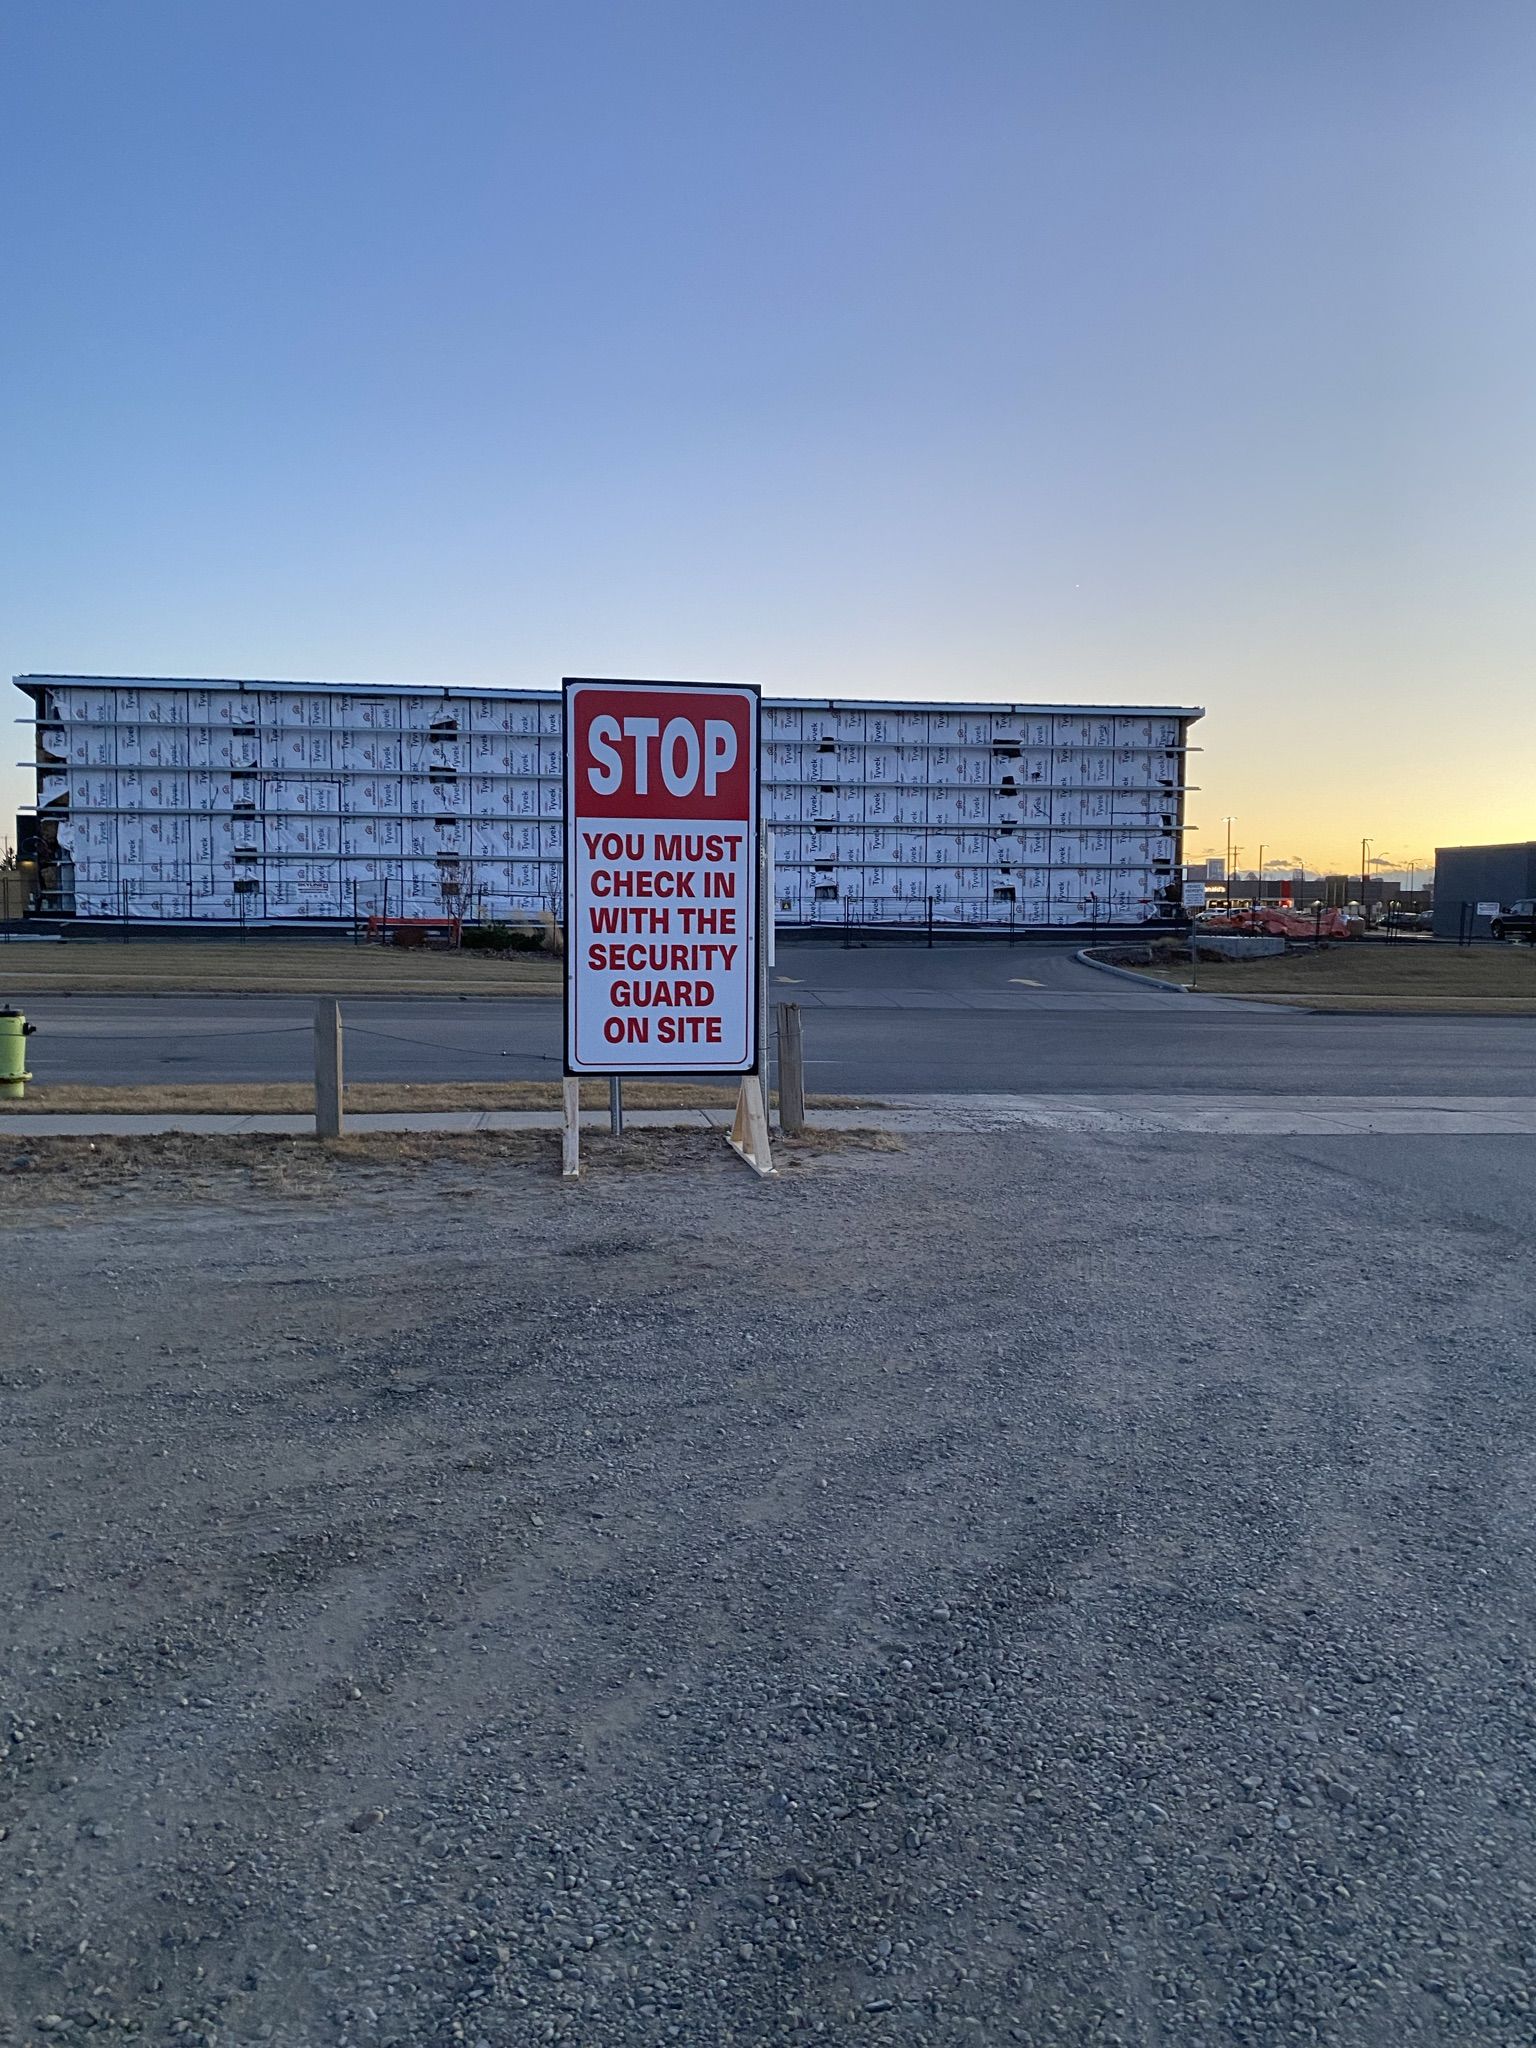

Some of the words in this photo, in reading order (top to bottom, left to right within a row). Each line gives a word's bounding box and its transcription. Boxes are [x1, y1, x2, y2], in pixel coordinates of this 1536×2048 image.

[873, 720, 882, 743] Tyvek
[383, 747, 391, 770] Tyvek
[549, 751, 557, 774] Tyvek
[587, 714, 738, 798] STOP
[810, 759, 819, 781] Tyvek
[872, 757, 881, 779] Tyvek
[973, 761, 981, 783] Tyvek
[383, 784, 391, 807] Tyvek
[549, 788, 557, 811] Tyvek
[809, 795, 818, 817] Tyvek
[872, 793, 881, 815] Tyvek
[973, 798, 981, 819] Tyvek
[384, 822, 393, 845] Tyvek
[522, 828, 530, 851] Tyvek
[128, 840, 137, 863] Tyvek
[201, 837, 210, 861] Tyvek
[583, 833, 644, 860] YOU
[655, 834, 743, 862] MUST
[522, 865, 530, 887] Tyvek
[591, 870, 695, 898] CHECK
[704, 872, 735, 898] IN
[589, 907, 669, 934] WITH
[678, 908, 736, 935] THE
[588, 943, 738, 971] SECURITY
[610, 980, 715, 1007] GUARD
[603, 1016, 649, 1044] ON
[658, 1017, 722, 1044] SITE
